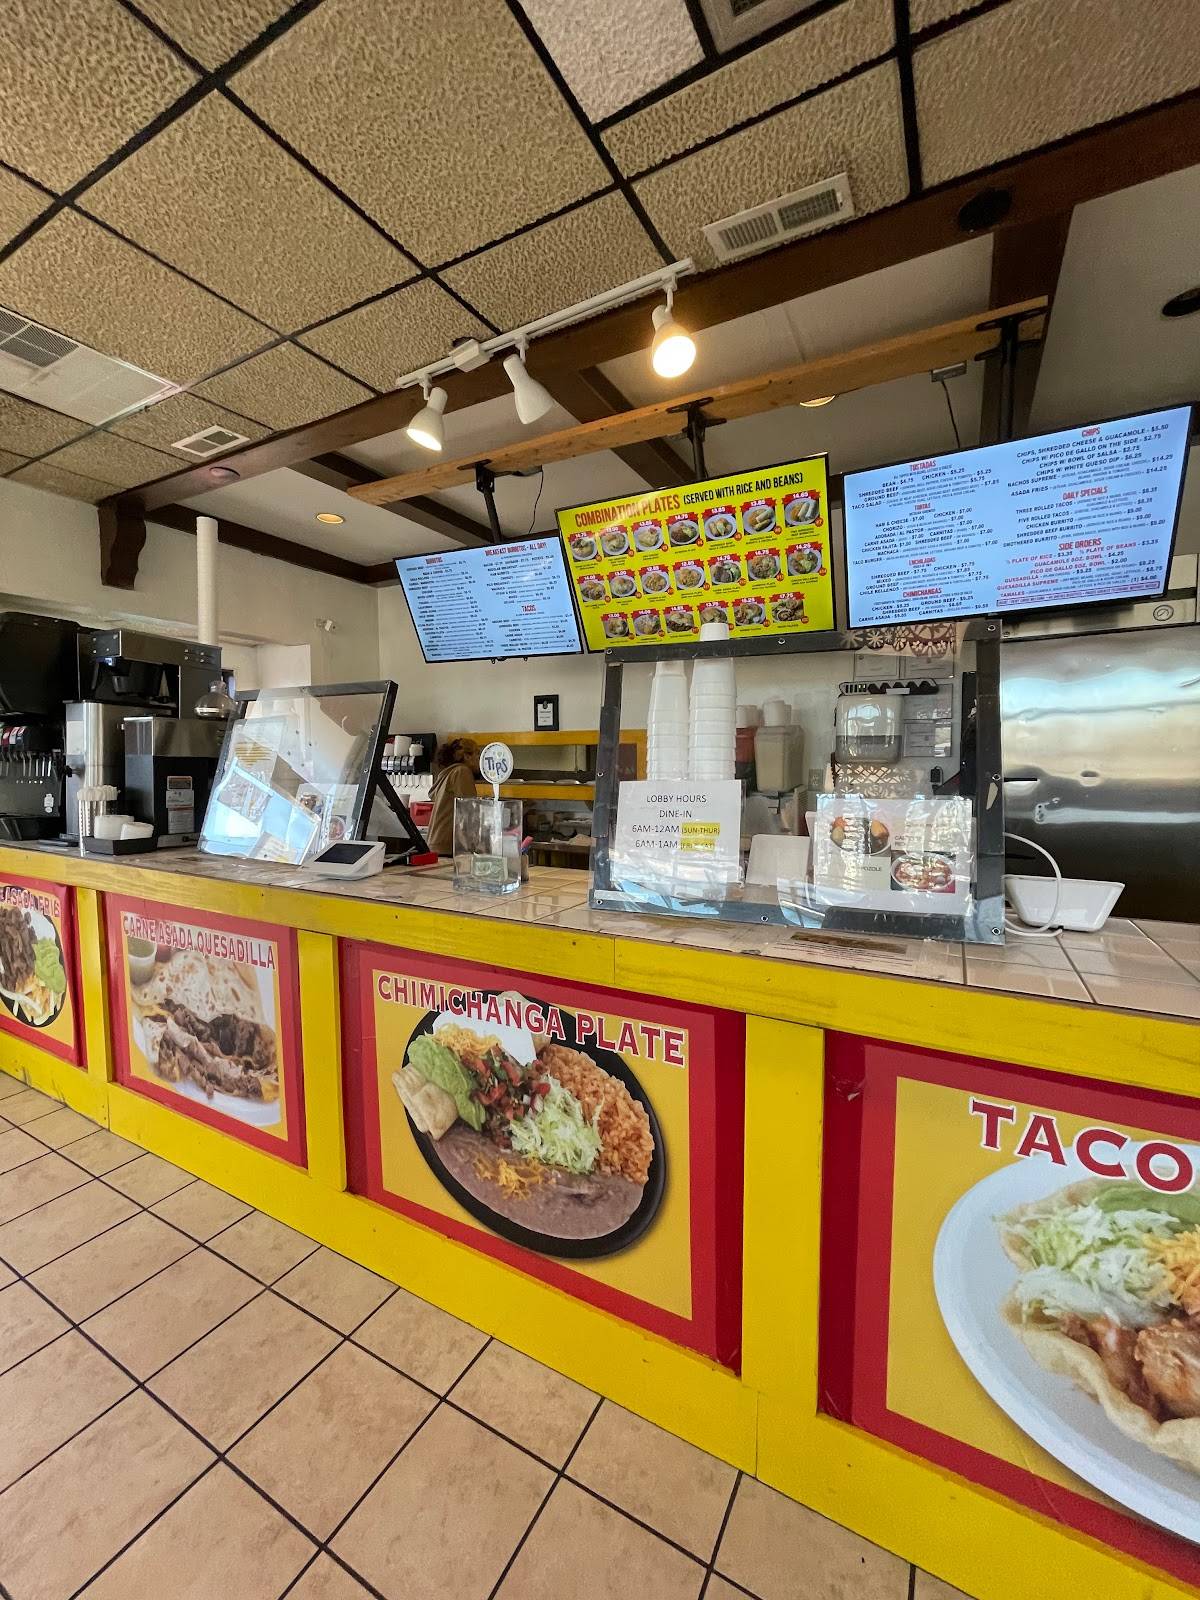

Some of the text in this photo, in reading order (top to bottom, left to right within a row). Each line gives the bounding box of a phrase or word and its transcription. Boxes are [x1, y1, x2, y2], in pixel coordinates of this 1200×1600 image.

[1072, 437, 1097, 448] CHEESE
[1104, 428, 1145, 442] GUACAMOLE
[1075, 445, 1096, 455] GALLO
[1097, 443, 1108, 451] ON
[1109, 441, 1122, 449] THE
[1123, 437, 1139, 446] SIDE
[1039, 460, 1058, 469] CHIPS
[1068, 455, 1086, 463] BOWL
[1097, 449, 1118, 458] SALSA
[1123, 445, 1140, 453] $2.75
[1036, 468, 1055, 476] CHIPS
[1064, 463, 1084, 471] WHITE
[922, 472, 946, 481] CHICKEN
[1008, 479, 1030, 488] NACHOS
[1031, 474, 1057, 484] SUPREME
[1031, 485, 1049, 493] FRIES
[1080, 485, 1108, 498] SPECIALS
[643, 494, 681, 515] PLATES
[716, 485, 734, 499] WITH
[737, 481, 753, 495] RICE
[755, 478, 771, 492] AND
[934, 510, 956, 518] CHICKEN
[1034, 504, 1054, 512] ROLLED
[1058, 538, 1102, 551] SIDE ORDERS
[521, 604, 536, 613] TACOS
[646, 795, 707, 803] LOBBY HOURS
[659, 810, 692, 818] DINE-IN
[632, 825, 720, 835] 6AM-12AM (SUN-THUR)
[635, 840, 678, 848] 6AM-1AM
[122, 915, 276, 970] CARNE ASADA QUESADILLA
[377, 973, 686, 1066] CHIMICHANGA PLATE
[969, 1096, 1195, 1195] TACO
